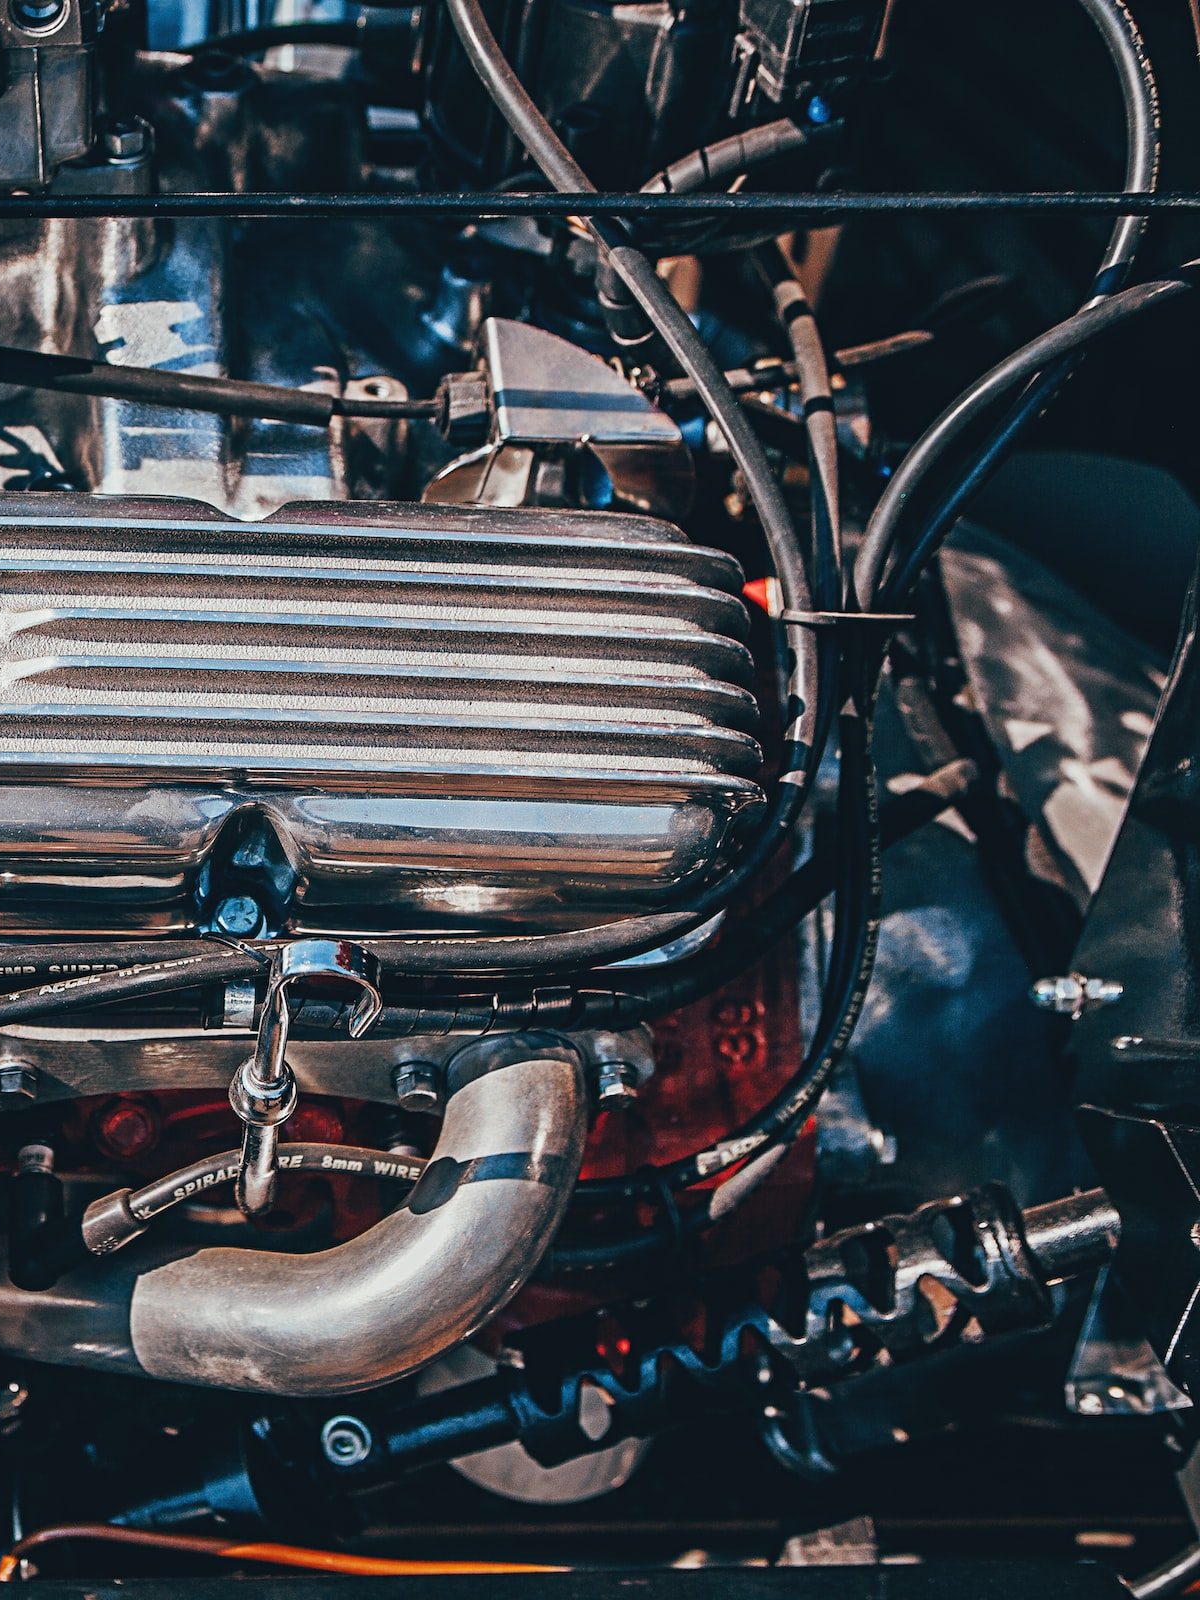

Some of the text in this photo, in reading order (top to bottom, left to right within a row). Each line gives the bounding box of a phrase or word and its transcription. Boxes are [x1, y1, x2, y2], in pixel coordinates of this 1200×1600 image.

[173, 1165, 240, 1203] SPIRAL
[321, 1154, 363, 1173] 8mm
[373, 1159, 421, 1183] WIRE
